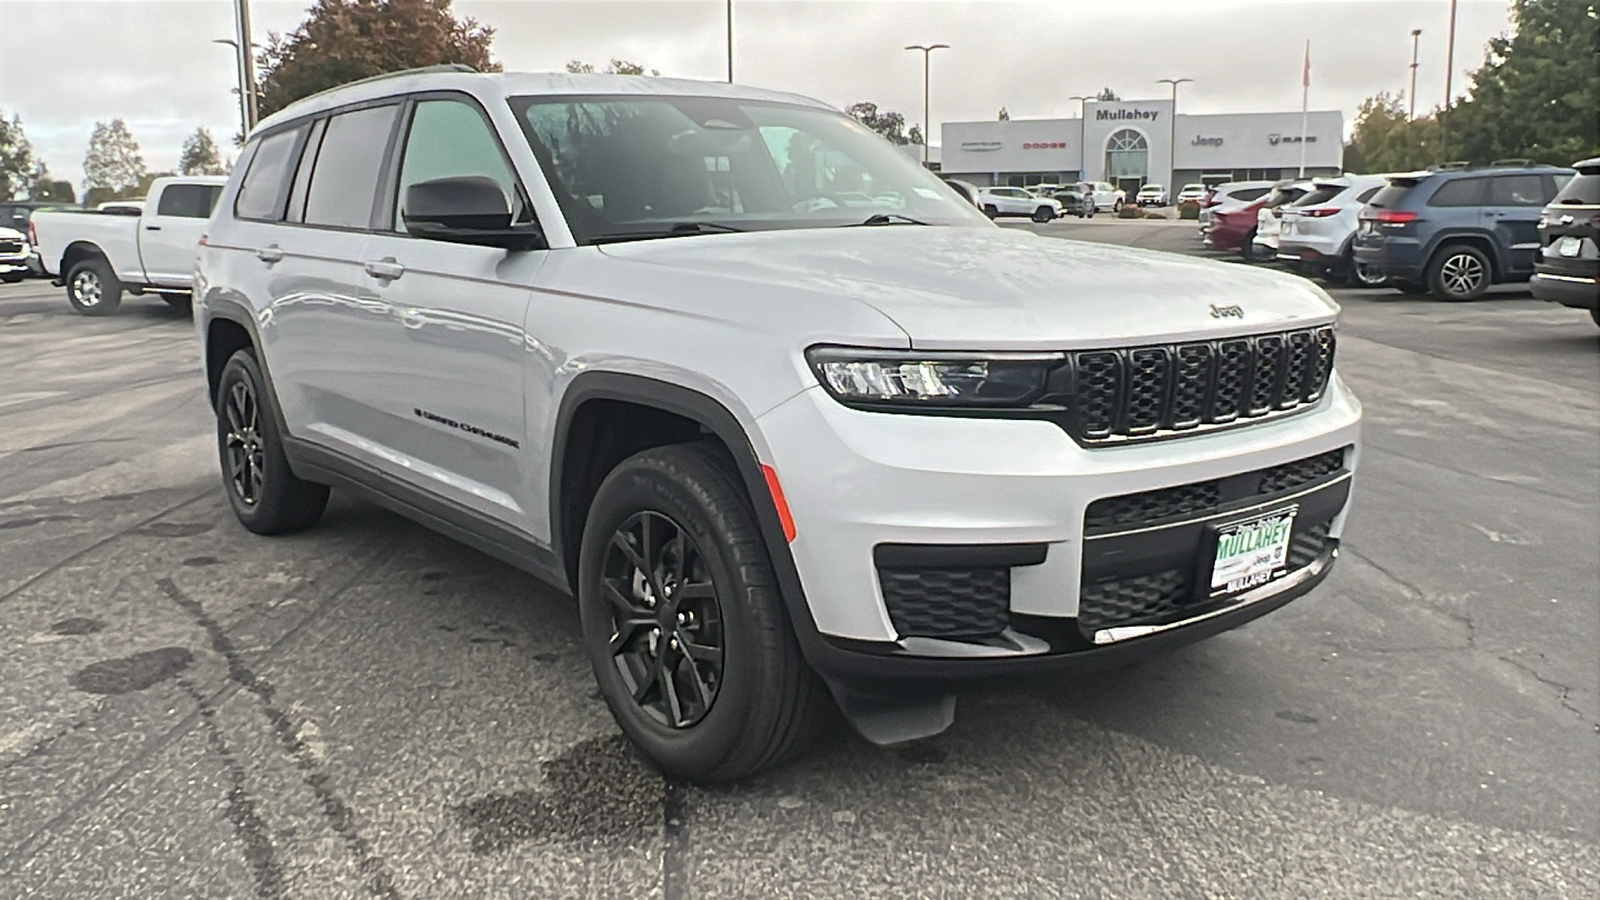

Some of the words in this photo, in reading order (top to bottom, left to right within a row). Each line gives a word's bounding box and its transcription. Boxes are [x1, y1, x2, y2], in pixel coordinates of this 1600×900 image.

[1096, 109, 1159, 122] Mullahey
[1022, 142, 1067, 150] DODGE
[1208, 303, 1245, 319] Jeep
[1218, 522, 1290, 560] MULLAHEY
